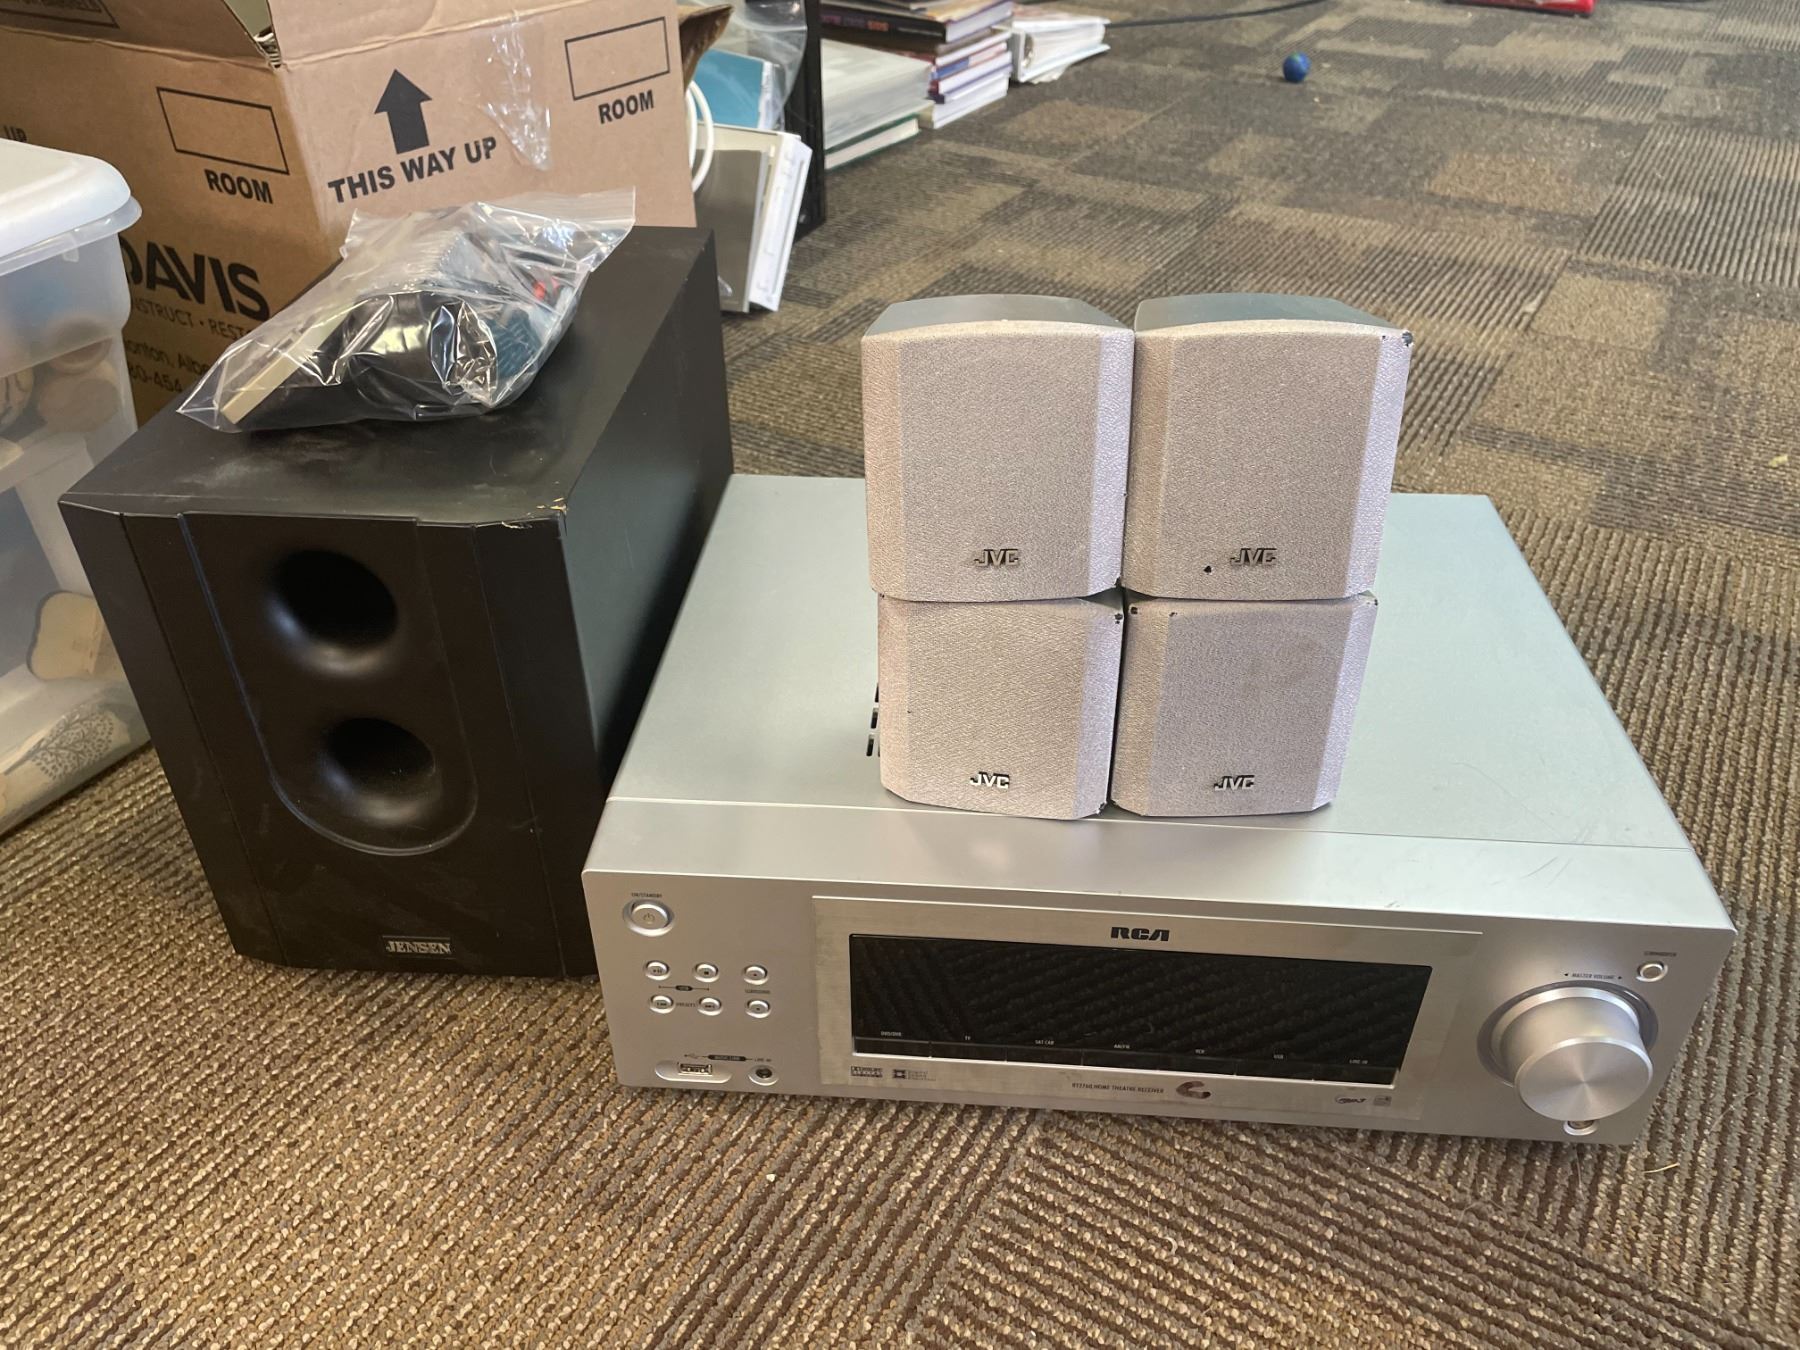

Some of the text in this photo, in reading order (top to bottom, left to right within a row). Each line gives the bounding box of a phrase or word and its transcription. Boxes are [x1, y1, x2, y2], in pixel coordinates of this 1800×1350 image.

[598, 88, 655, 125] ROOM
[327, 136, 497, 203] THIS WAY UP
[204, 168, 274, 205] ROOM
[134, 298, 252, 342] STRUCT REST
[973, 547, 1020, 568] JVC
[1230, 547, 1277, 567] JVC
[969, 771, 1011, 789] JVC
[1213, 774, 1256, 791] JVC
[1111, 926, 1170, 942] RCA
[385, 940, 452, 955] JENSEN
